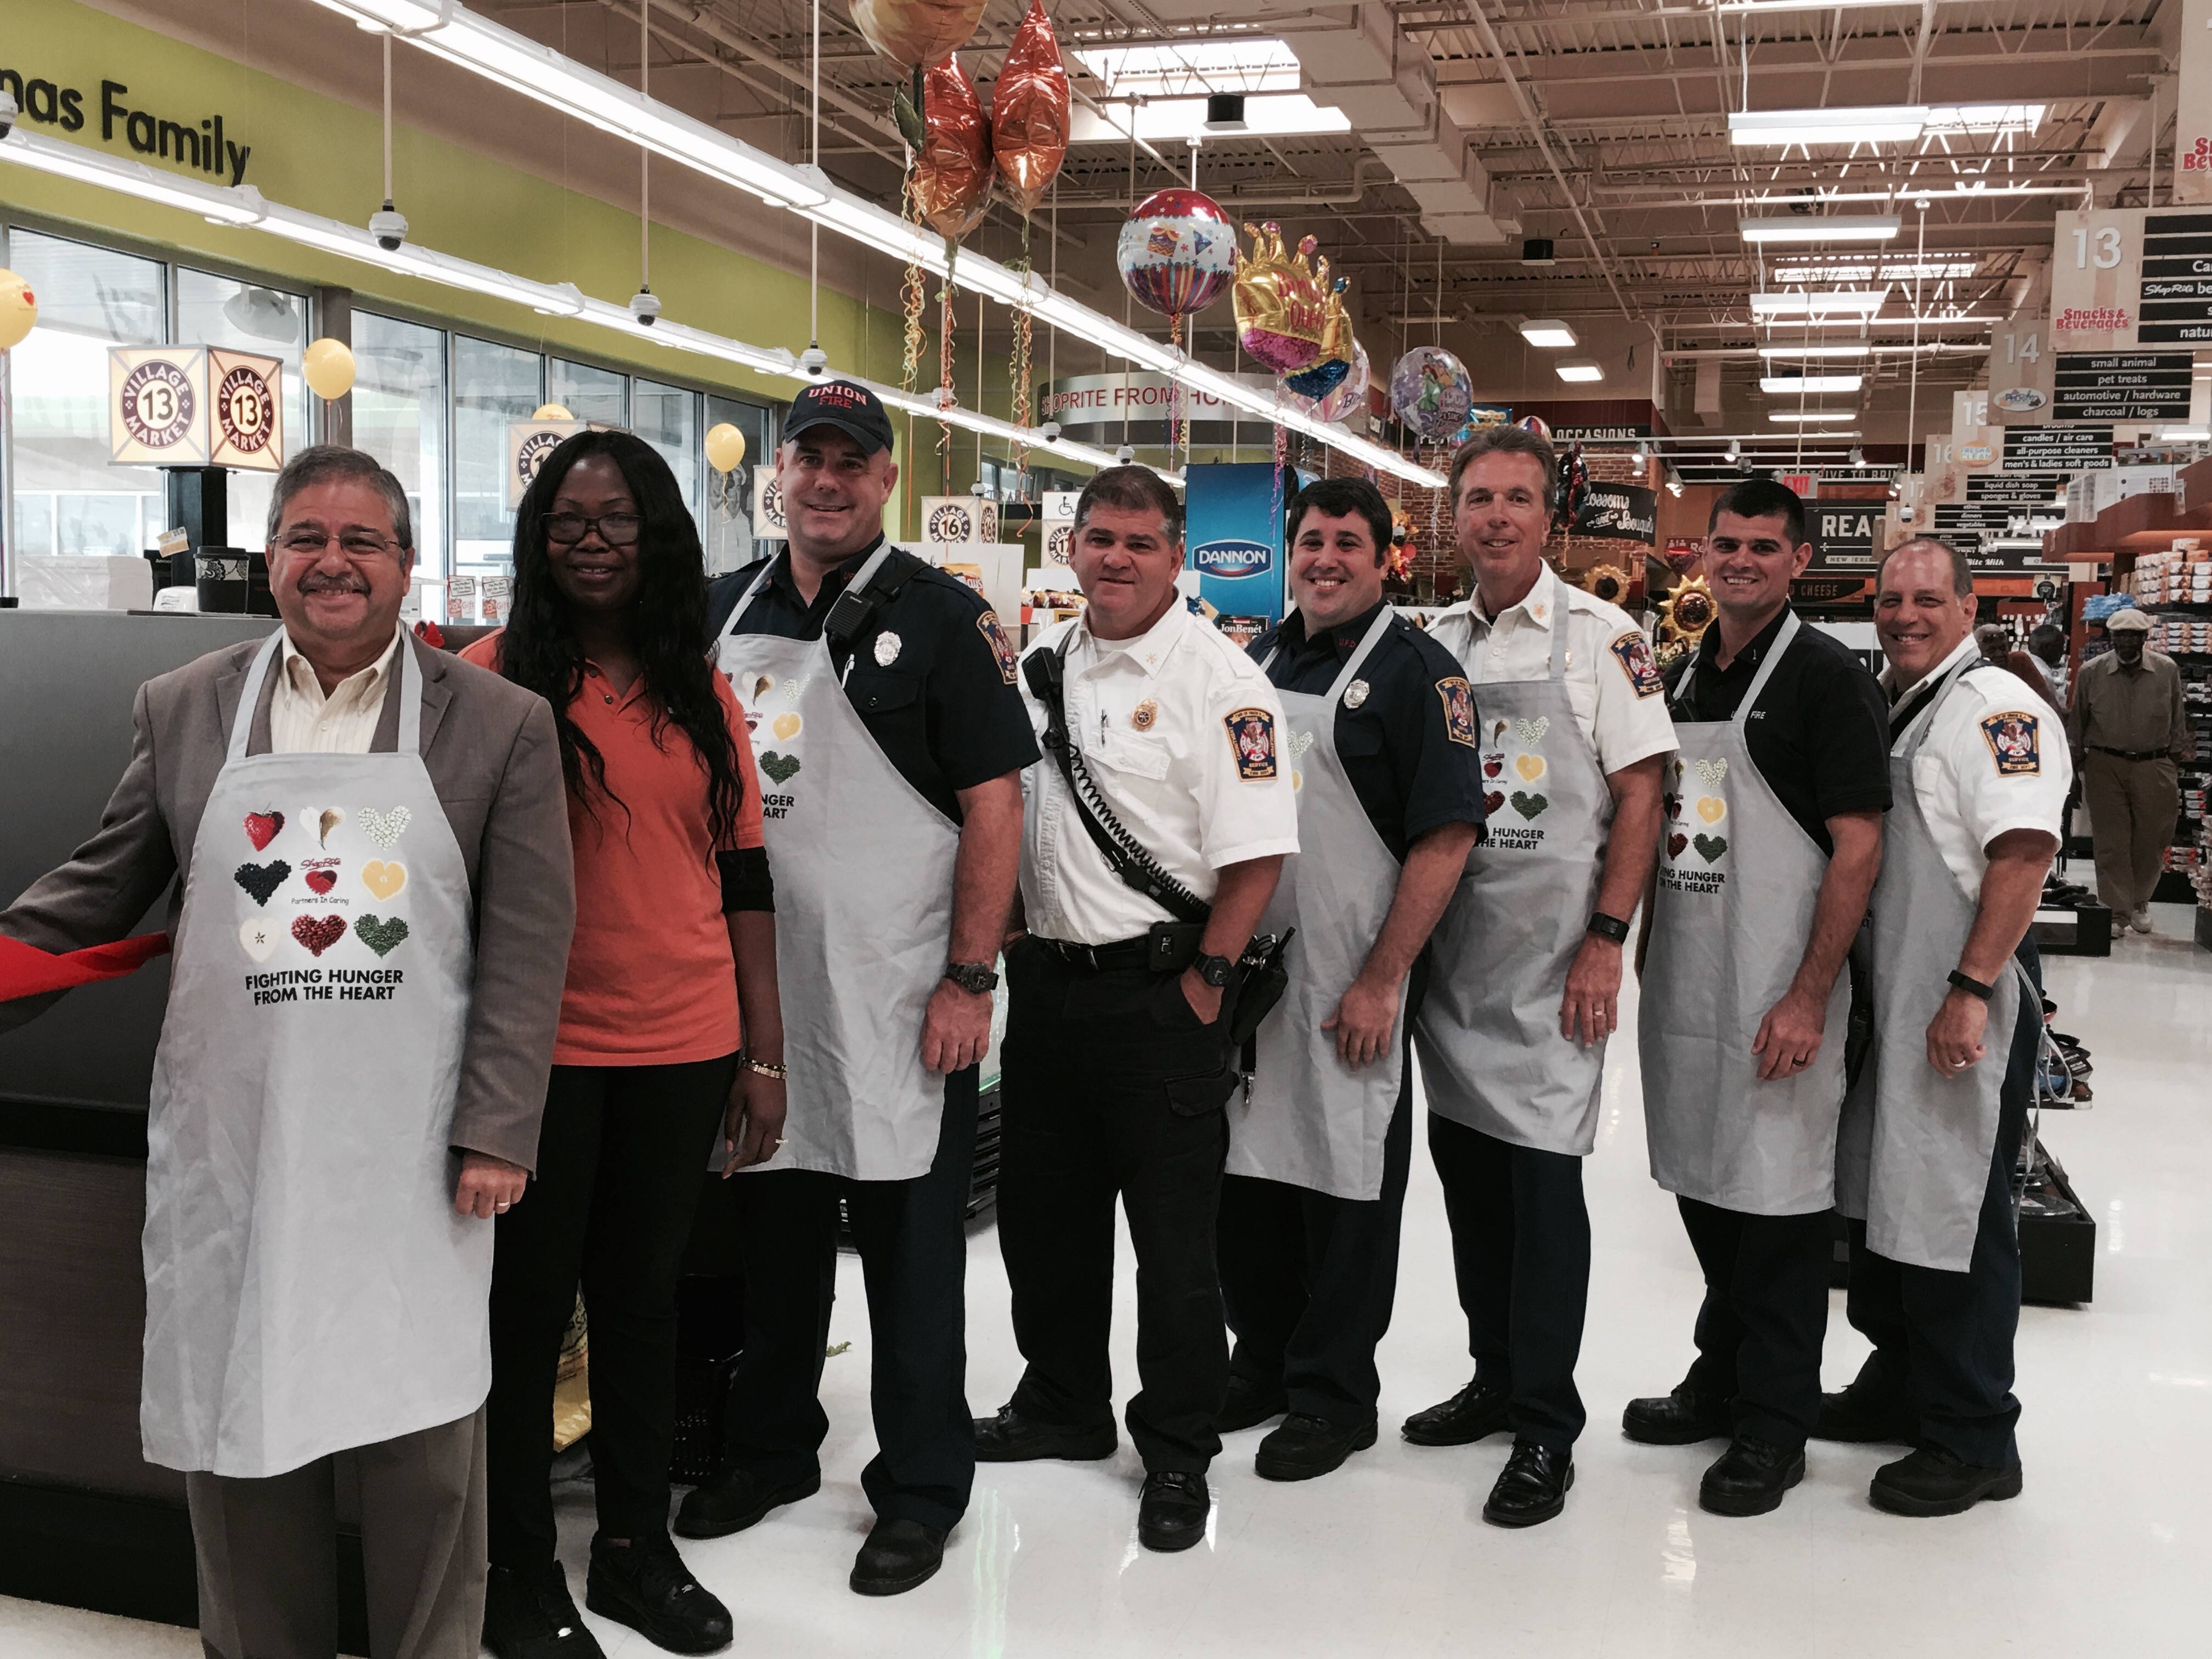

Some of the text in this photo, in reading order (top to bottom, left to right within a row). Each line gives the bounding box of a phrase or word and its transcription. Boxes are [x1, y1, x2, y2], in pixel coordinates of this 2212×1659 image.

[101, 80, 251, 188] Family
[2072, 227, 2121, 268] 13
[2064, 307, 2115, 320] Snacks
[2056, 318, 2129, 332] Beverages
[2004, 334, 2040, 364] 14
[2091, 357, 2156, 368] small animal
[124, 365, 189, 398] VILLAGE
[221, 371, 269, 404] VILLAGE
[2097, 375, 2147, 386] pet treats
[808, 385, 867, 406] UNION
[1041, 389, 1107, 415] SHOPRITE
[1114, 387, 1177, 406] FROM
[2063, 391, 2121, 400] automotive
[2133, 390, 2181, 400] hardware
[143, 388, 173, 420] 13
[819, 396, 851, 409] FIRE
[235, 394, 258, 426] 13
[1963, 401, 1987, 426] 15
[2083, 407, 2125, 417] charcoal
[2137, 407, 2159, 418] logs
[126, 413, 189, 445] MARKET
[222, 418, 270, 450] MARKET
[1556, 428, 1636, 439] OCCASIONS
[520, 435, 563, 459] VILLA
[2017, 447, 2062, 456] all-purpose
[2084, 459, 2109, 469] goods
[1784, 476, 1810, 494] EXIT
[931, 506, 968, 523] VILLAGE
[941, 518, 958, 535] 16
[1199, 550, 1266, 564] DANNON
[1801, 585, 1837, 596] CHEESE
[1220, 624, 1262, 634] JonBenét
[1751, 711, 1766, 719] FIRE
[761, 794, 794, 807] NGER
[763, 807, 788, 819] ART
[1493, 827, 1544, 839] HUNGER
[1500, 839, 1538, 850] HEART
[1679, 870, 1725, 883] HUNGER
[1667, 879, 1681, 890] THE
[1685, 882, 1719, 894] HEART
[329, 898, 349, 906] Caring
[245, 969, 403, 990] FIGHTING HUNGER
[254, 986, 395, 1006] FROM THE HEART
